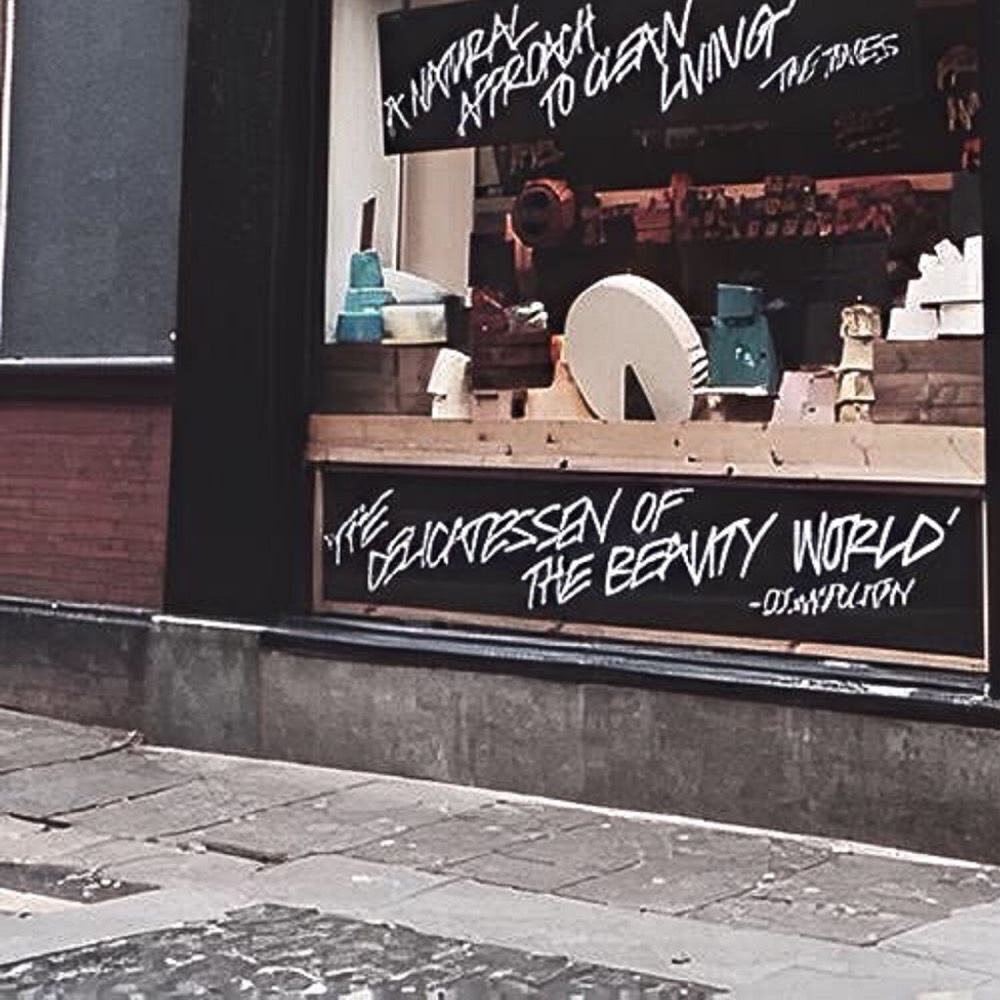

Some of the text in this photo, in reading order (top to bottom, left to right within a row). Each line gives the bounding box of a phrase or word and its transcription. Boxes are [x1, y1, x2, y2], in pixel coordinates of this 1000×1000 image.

[411, 3, 540, 117] NATURAL
[457, 3, 596, 137] APPROACH
[539, 72, 576, 128] TO
[367, 487, 695, 592] DELICATESSEN OF
[521, 552, 595, 610] THE
[605, 511, 779, 597] BEAUTY
